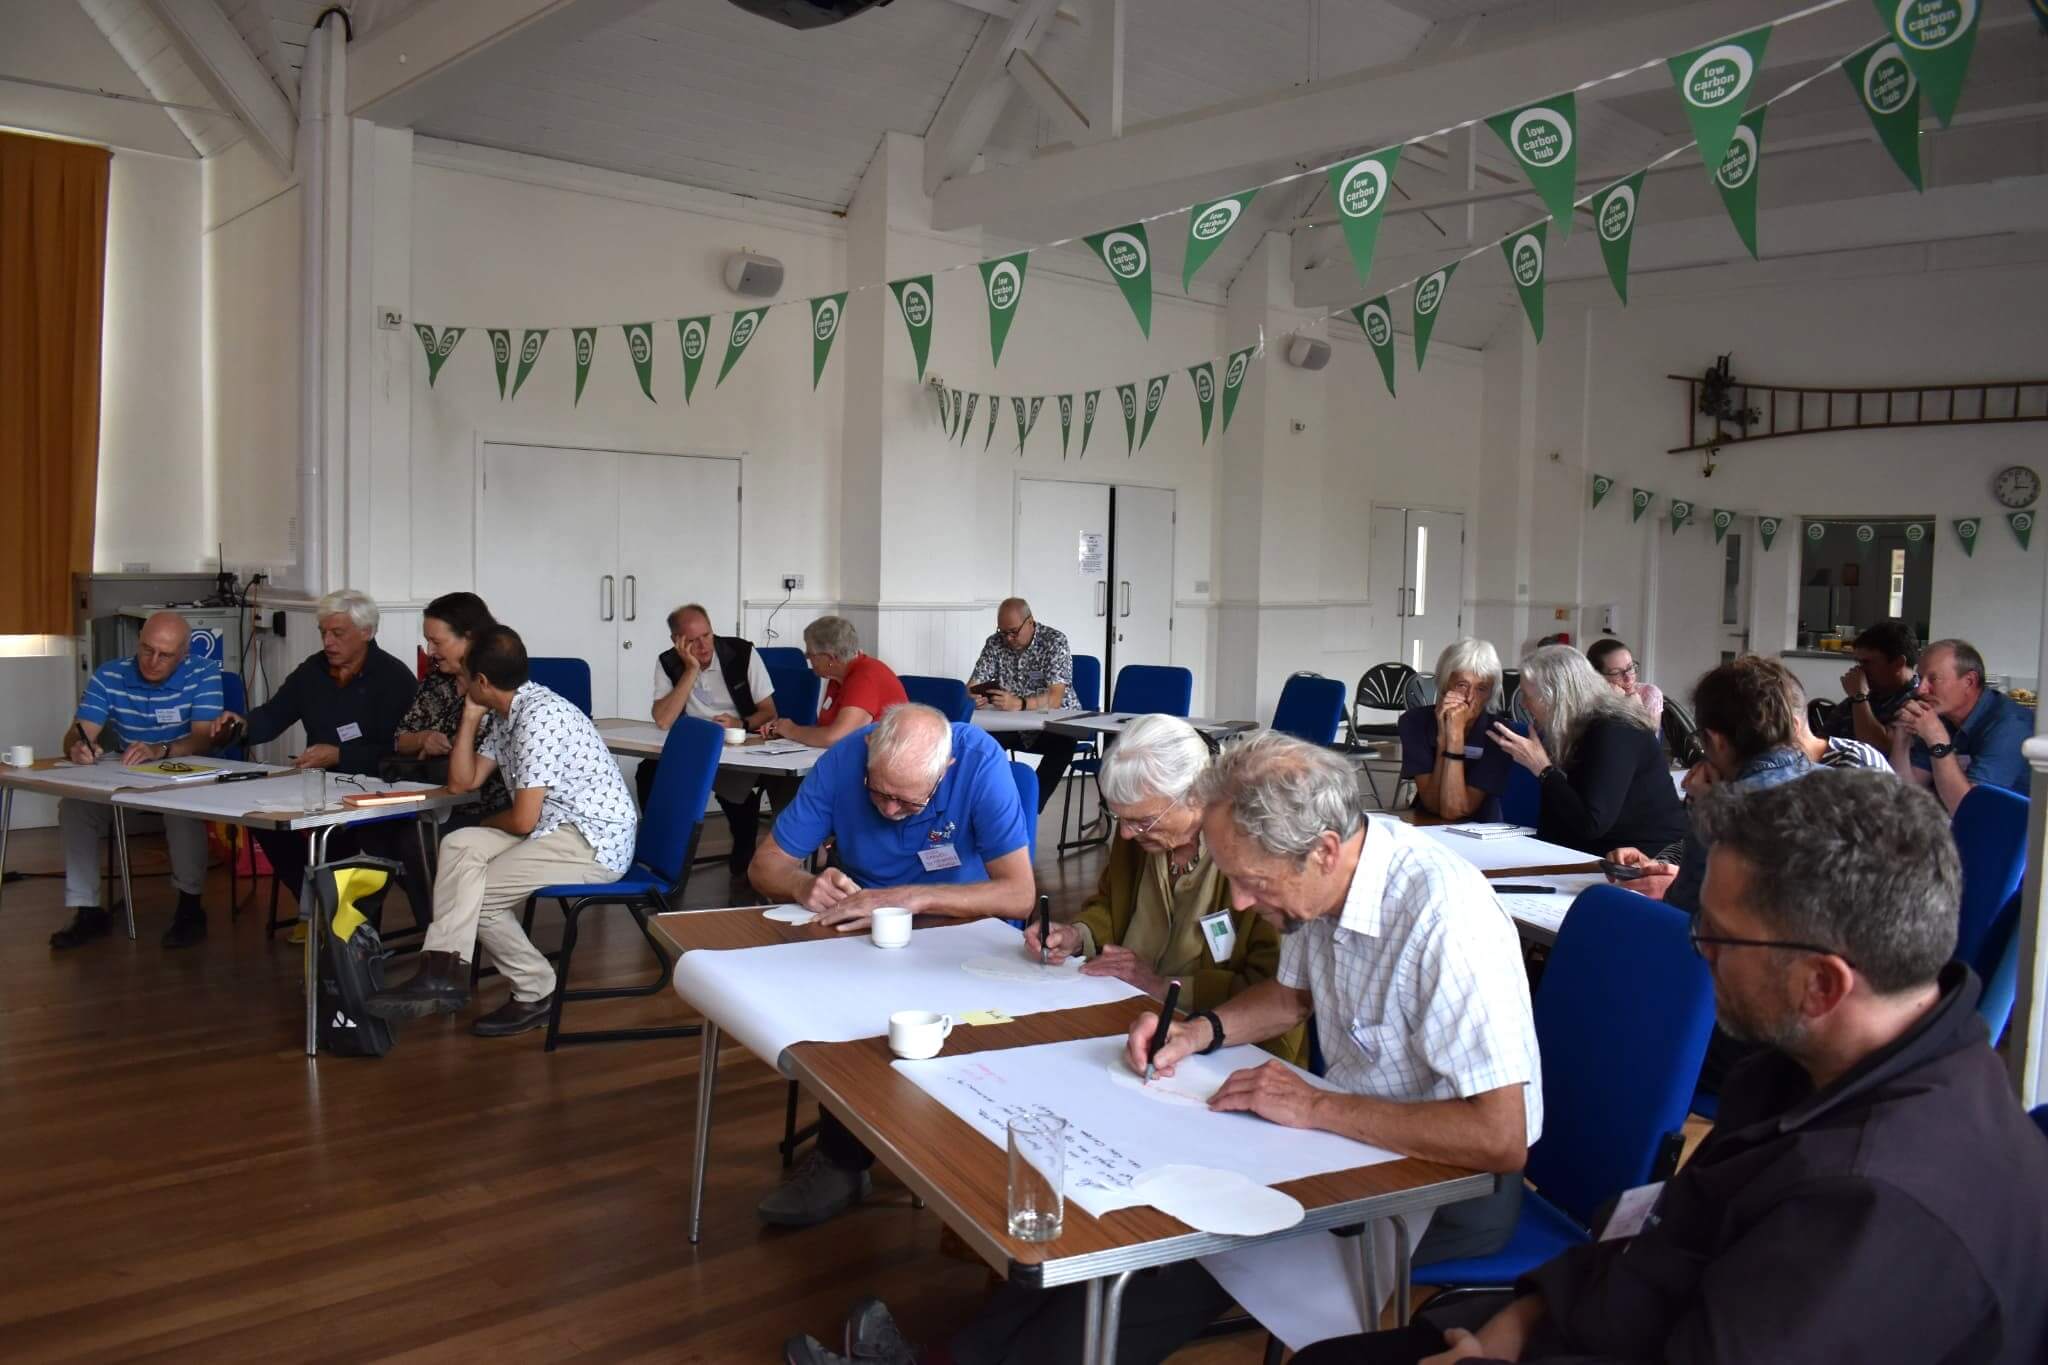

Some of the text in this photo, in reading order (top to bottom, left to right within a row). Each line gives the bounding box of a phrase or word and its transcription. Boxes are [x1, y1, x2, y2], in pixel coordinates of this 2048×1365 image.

[1918, 1, 1941, 15] low
[1909, 10, 1956, 31] carbon
[1921, 24, 1946, 42] hub
[1704, 65, 1725, 78] low
[1878, 66, 1895, 81] low
[1694, 73, 1735, 92] carbon
[1873, 74, 1905, 97] carbon
[1703, 87, 1725, 100] hub
[1882, 90, 1901, 106] hub
[1525, 126, 1545, 137] low
[1523, 134, 1558, 151] carbon
[1534, 146, 1554, 160] hub
[1727, 145, 1740, 157] low
[1722, 154, 1747, 173] carbon
[1729, 167, 1743, 180] hub
[1353, 178, 1368, 190] low
[1346, 186, 1375, 202] carbon
[1352, 199, 1368, 210] hub
[1609, 203, 1621, 213] low
[1209, 212, 1224, 220] low
[1604, 212, 1626, 227] carbon
[1199, 218, 1227, 229] carbon
[1609, 222, 1621, 234] hub
[1201, 226, 1217, 235] hub
[1113, 245, 1127, 255] low
[1113, 253, 1137, 265] carbon
[1121, 263, 1135, 273] hub
[1518, 260, 1535, 272] carbon
[1522, 269, 1533, 280] hub
[994, 285, 1012, 296] carbon
[997, 294, 1008, 303] hub
